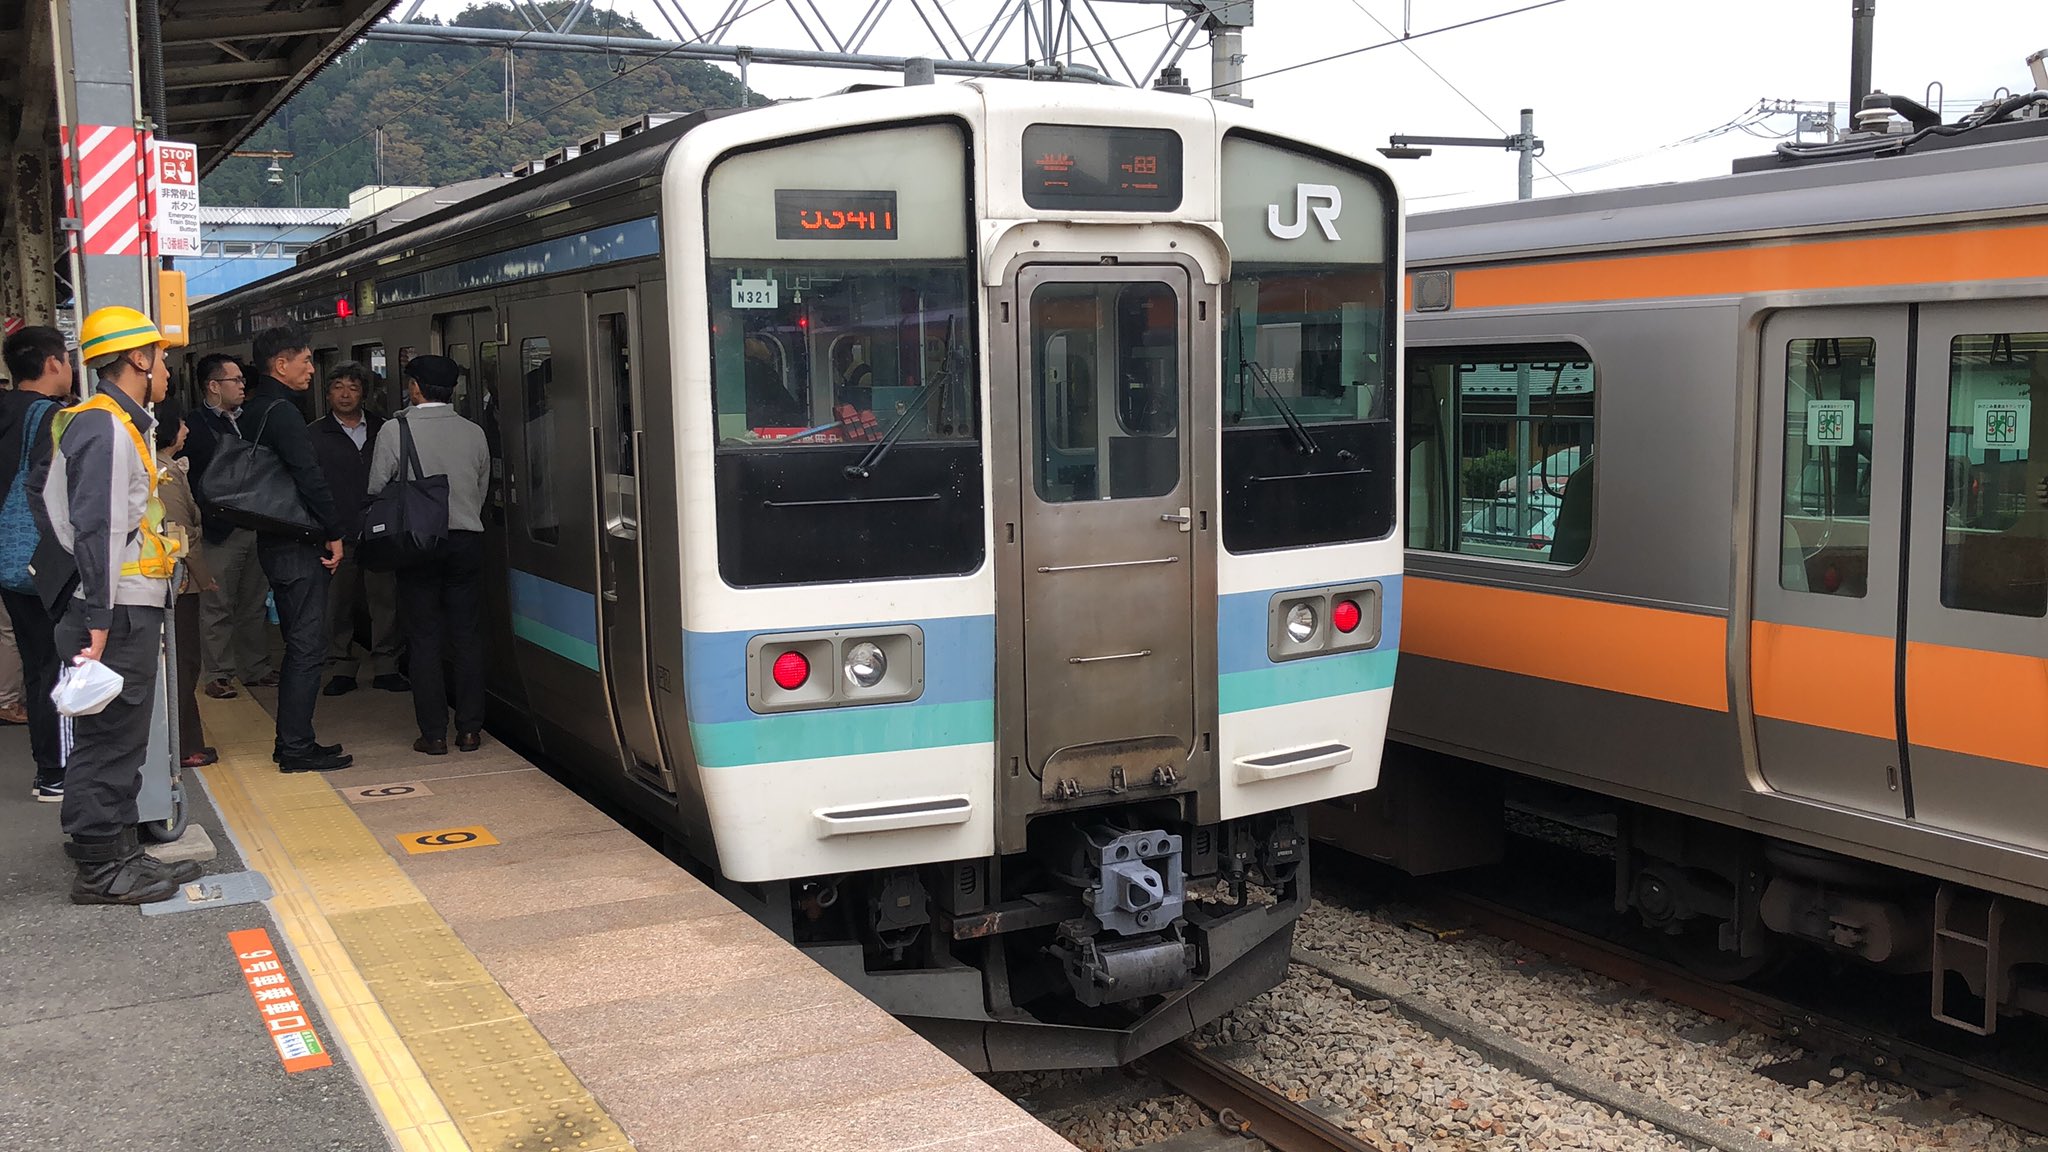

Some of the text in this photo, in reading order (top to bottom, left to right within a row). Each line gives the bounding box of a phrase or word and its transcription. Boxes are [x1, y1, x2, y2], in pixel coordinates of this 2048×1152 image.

[161, 148, 192, 160] STOP
[161, 188, 196, 200] 非常停止
[171, 201, 196, 212] ボタン
[1268, 183, 1341, 240] JR
[168, 212, 197, 220] Emergency
[738, 291, 770, 303] N321
